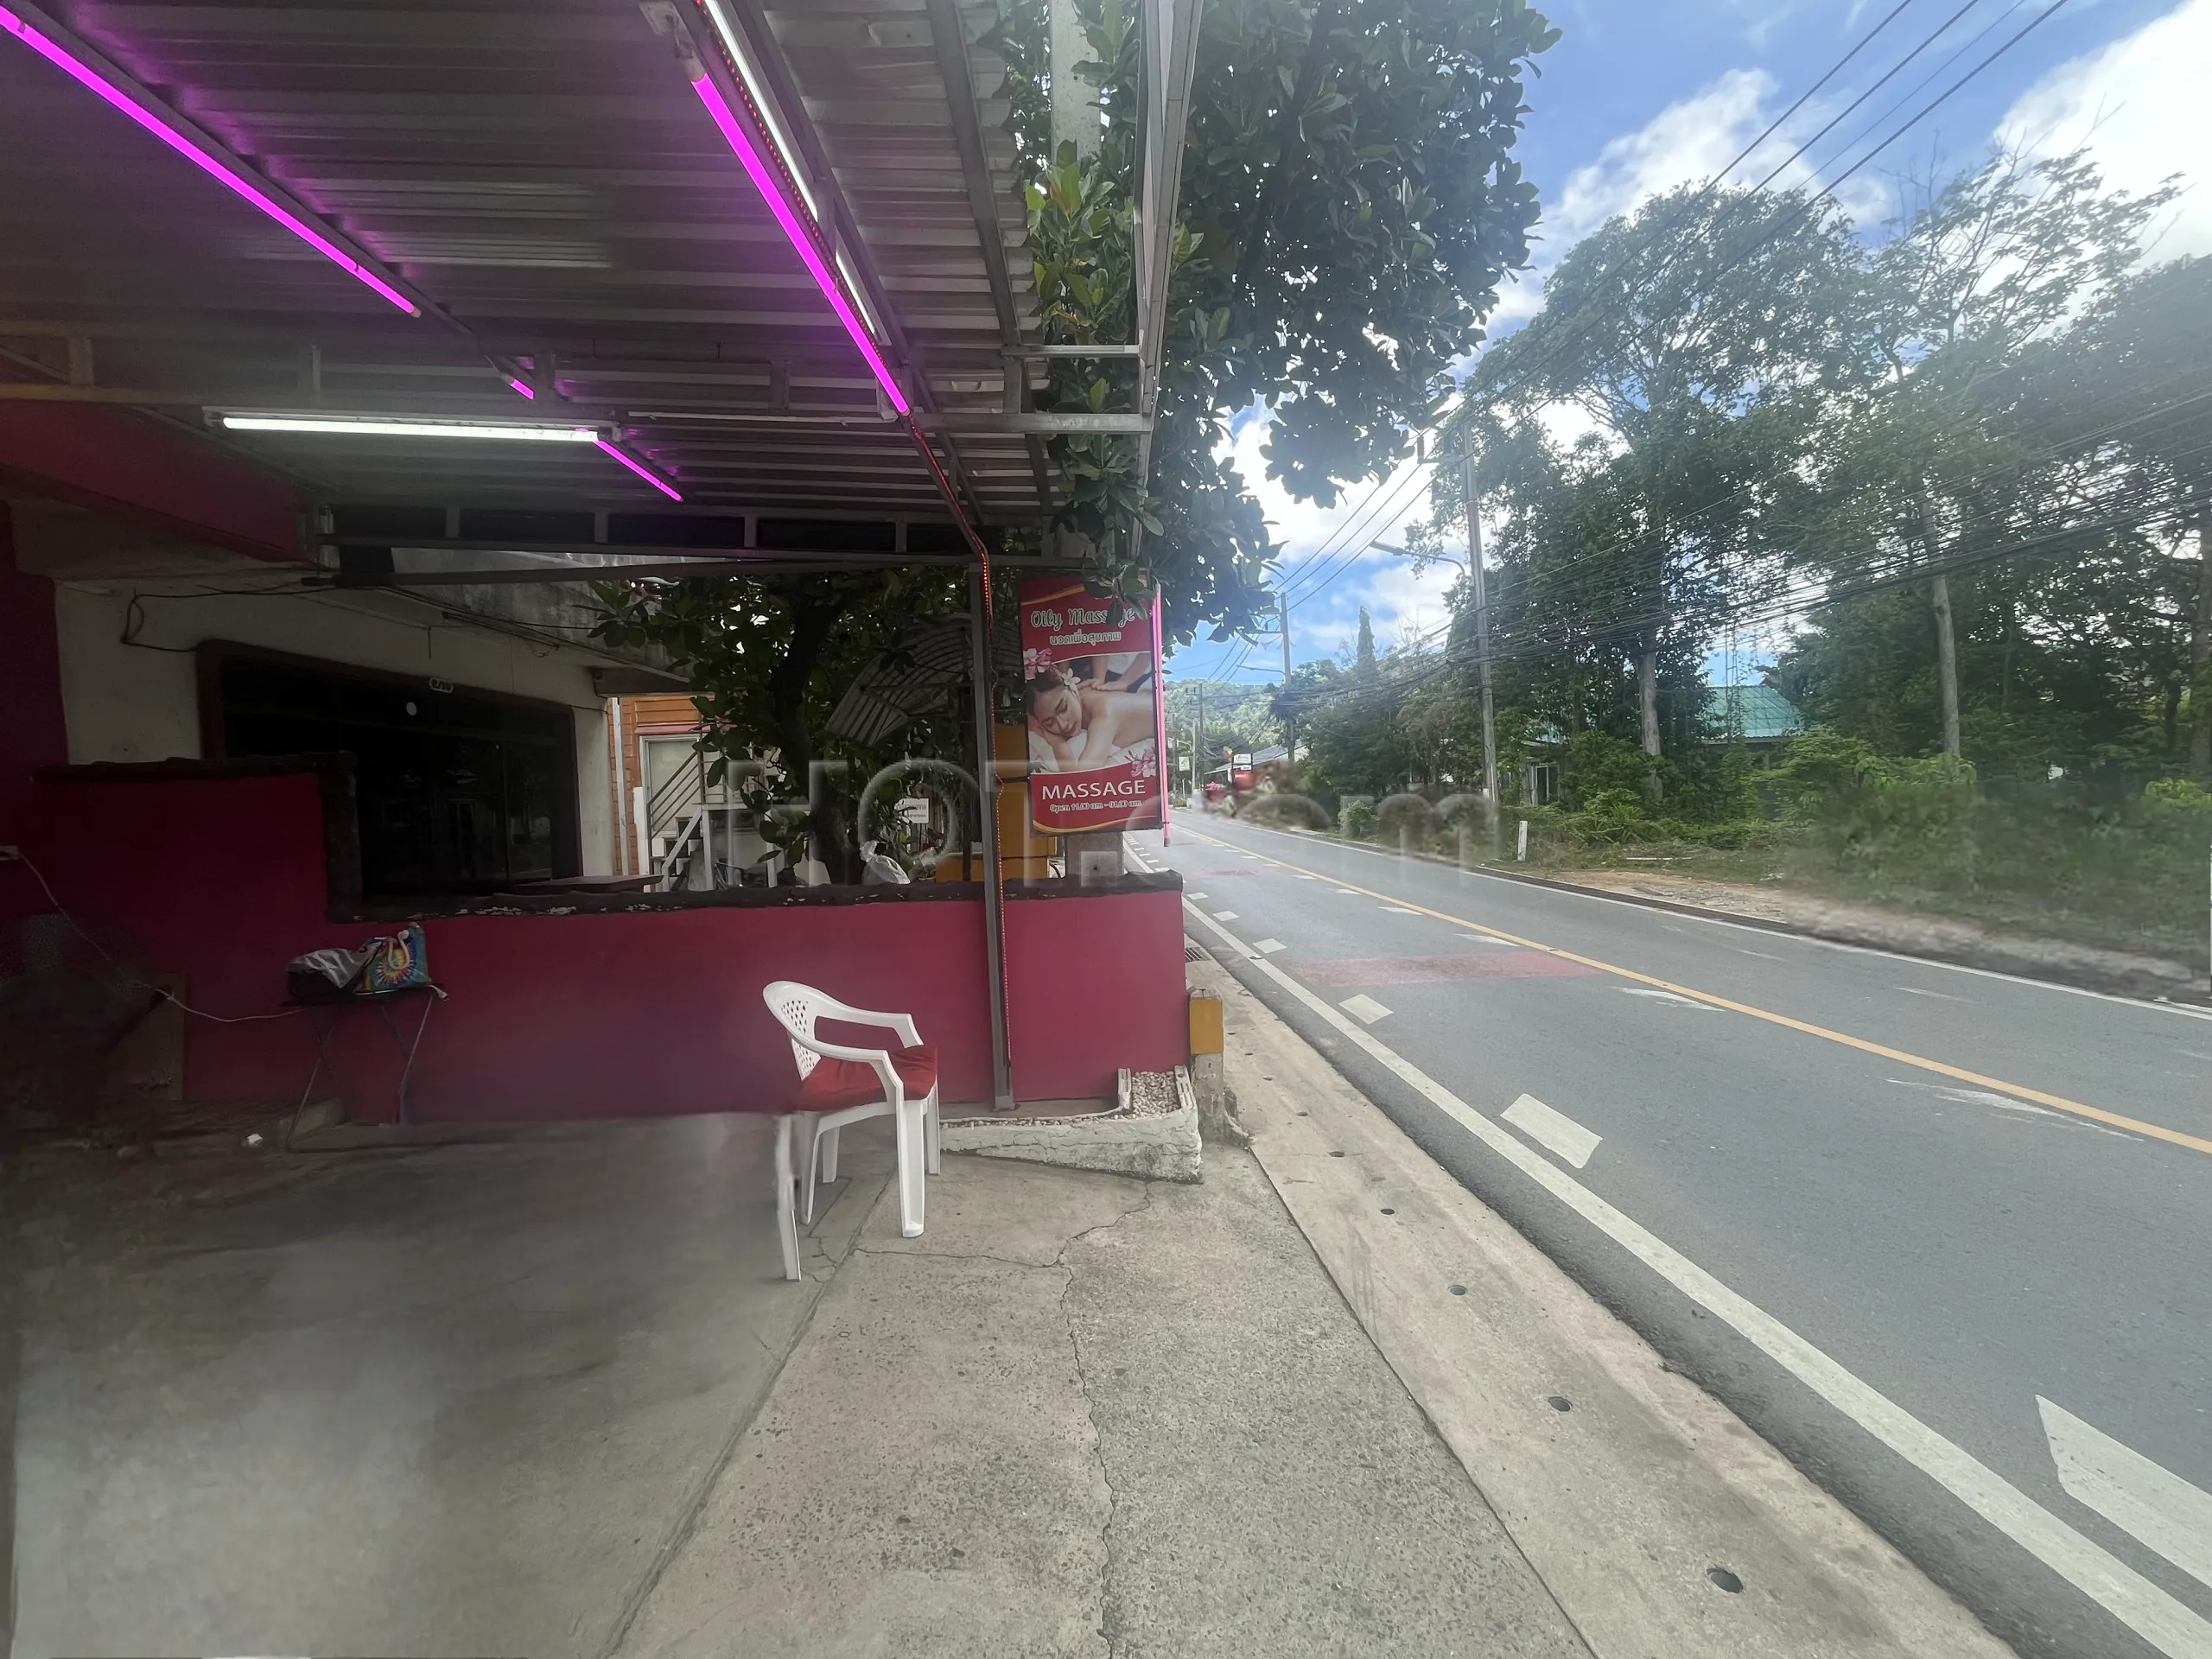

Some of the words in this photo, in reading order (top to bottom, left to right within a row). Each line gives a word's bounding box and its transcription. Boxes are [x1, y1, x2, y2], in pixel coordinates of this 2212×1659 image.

[1031, 608, 1063, 632] Oily
[1068, 607, 1135, 627] Massge
[1042, 779, 1146, 800] MASSAGE
[1050, 804, 1071, 814] Open
